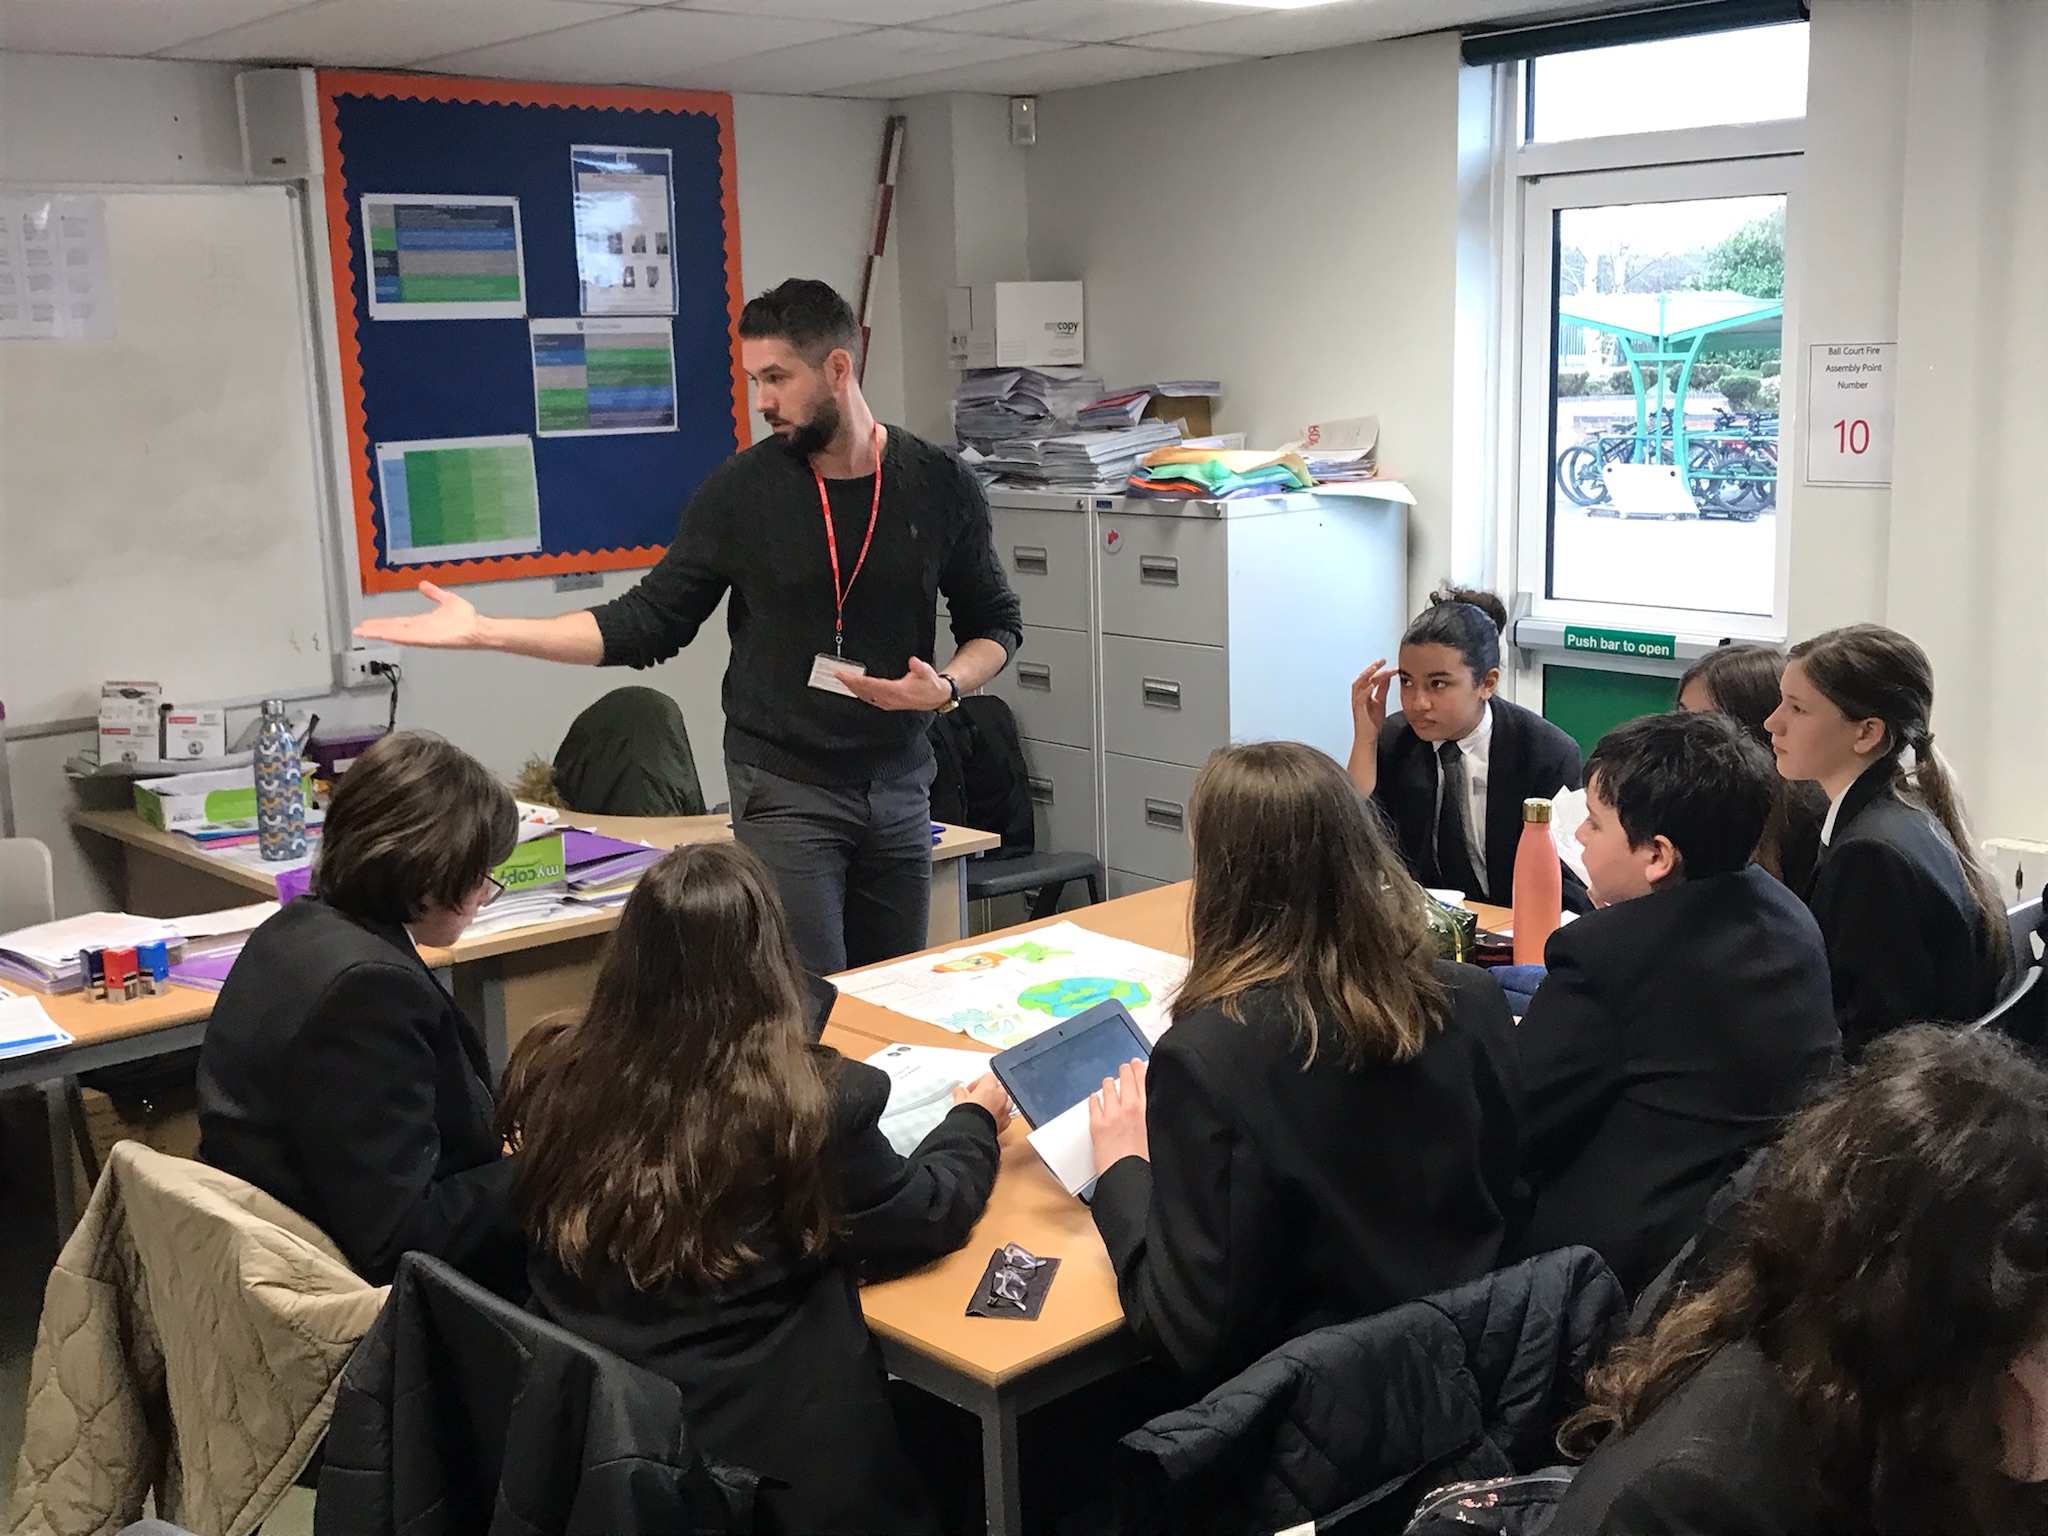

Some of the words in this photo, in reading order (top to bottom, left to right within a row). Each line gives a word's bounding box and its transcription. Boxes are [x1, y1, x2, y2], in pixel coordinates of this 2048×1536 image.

[1045, 321, 1079, 333] copy
[1828, 347, 1842, 356] Ball
[1843, 347, 1865, 356] Court
[1866, 346, 1880, 355] Fire
[1825, 364, 1861, 374] Assembly
[1862, 363, 1882, 372] Point
[1837, 381, 1868, 389] Number
[1834, 419, 1870, 455] 10
[1567, 634, 1598, 649] Push
[1600, 637, 1621, 650] bar
[1622, 639, 1636, 652] to
[1638, 643, 1670, 656] open
